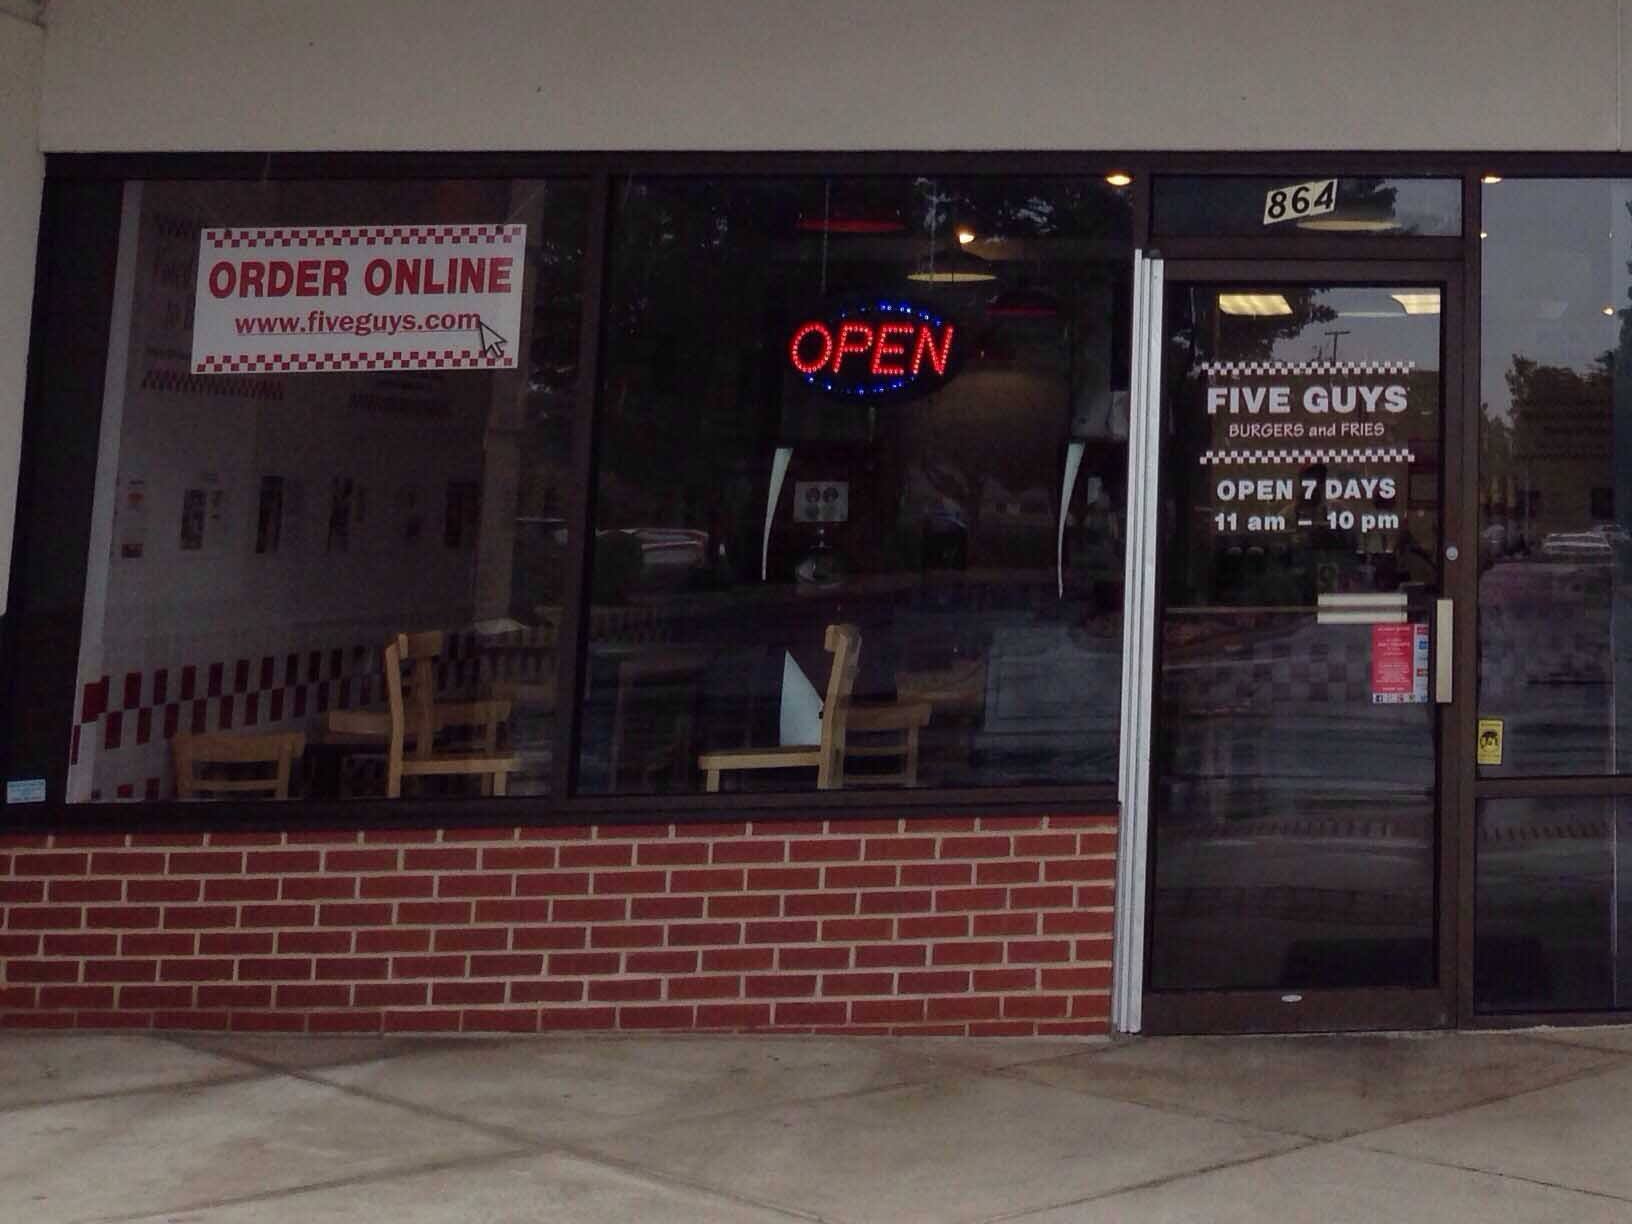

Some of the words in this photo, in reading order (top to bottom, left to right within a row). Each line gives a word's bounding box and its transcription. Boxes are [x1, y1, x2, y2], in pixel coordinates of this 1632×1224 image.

[1268, 181, 1334, 219] 864
[208, 260, 349, 298] ORDER
[364, 257, 513, 296] ONLINE
[235, 310, 481, 336] www.fiveguys.com
[790, 323, 954, 375] OPEN
[1207, 386, 1291, 414] FIVE
[1303, 385, 1408, 413] GUYS
[1229, 424, 1304, 438] BURGERS
[1309, 424, 1336, 437] and
[1341, 422, 1385, 436] FRIES
[1217, 479, 1293, 500] OPEN
[1302, 479, 1317, 500] 7
[1325, 478, 1397, 499] DAYS
[1215, 512, 1237, 531] 11
[1247, 515, 1286, 531] am
[1327, 511, 1354, 529] 10
[1361, 514, 1399, 533] pm
